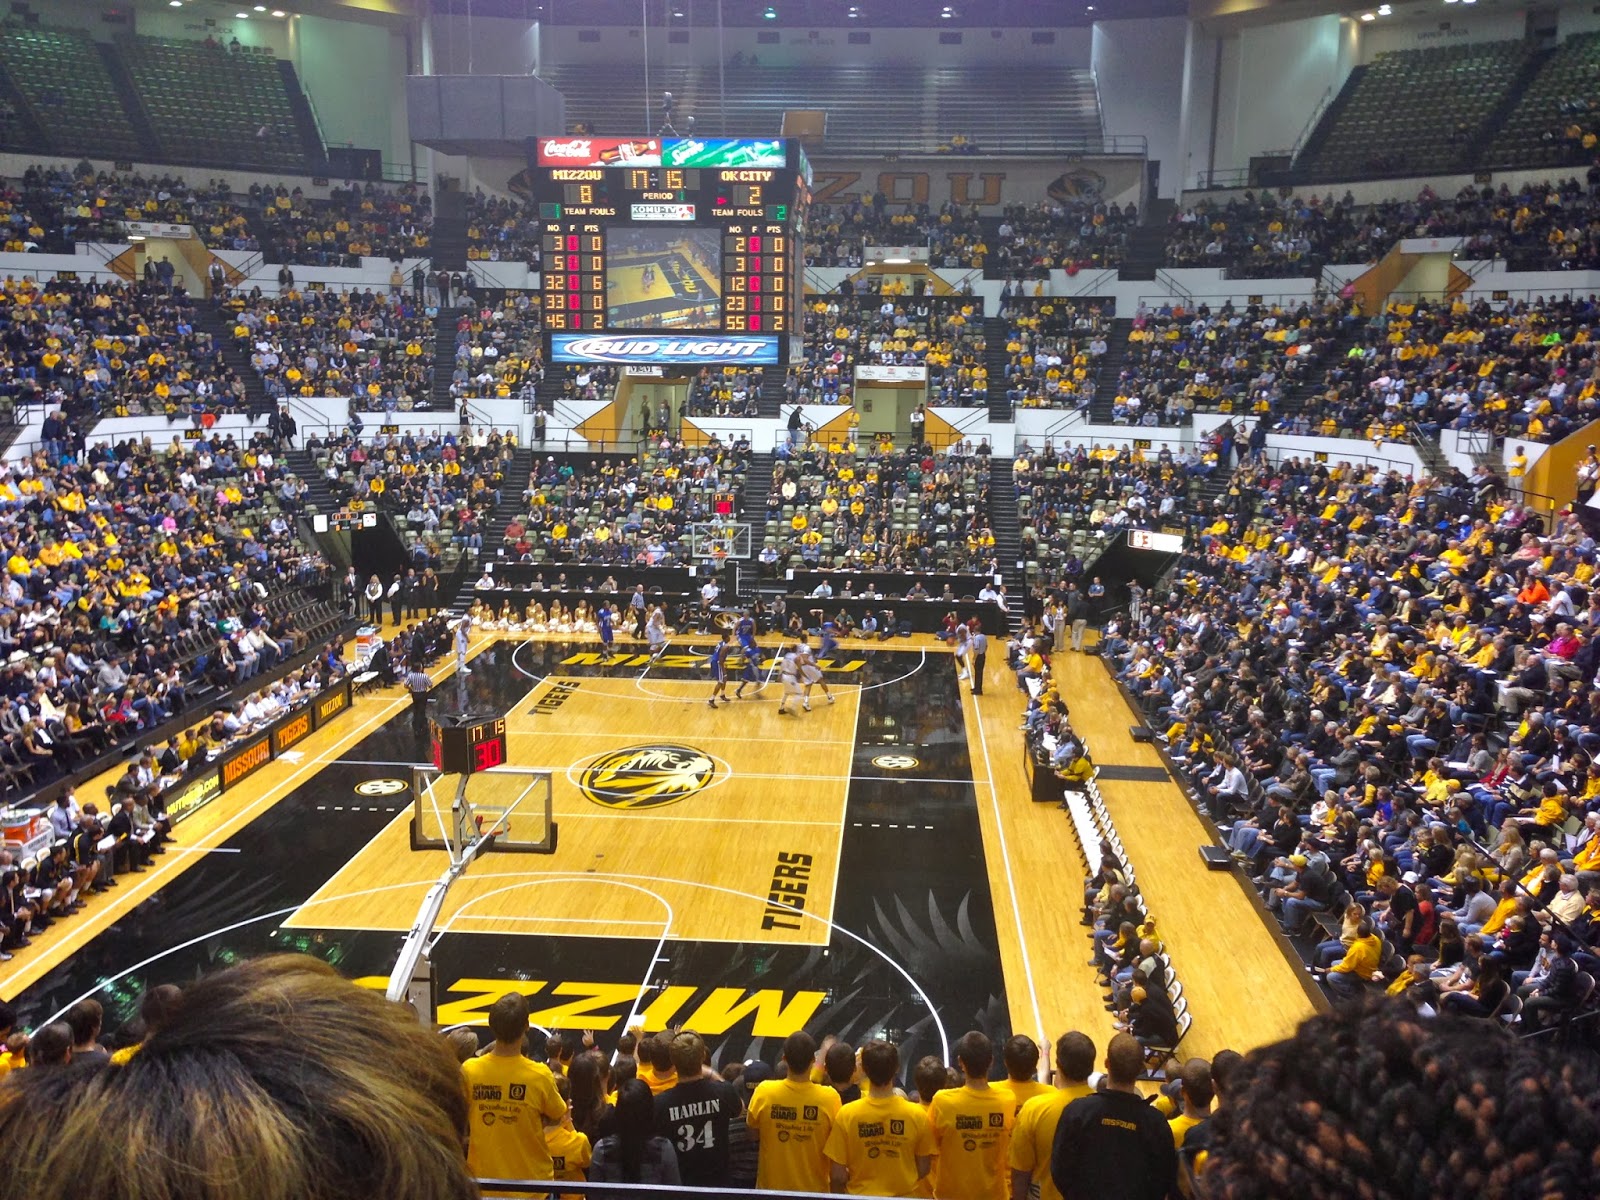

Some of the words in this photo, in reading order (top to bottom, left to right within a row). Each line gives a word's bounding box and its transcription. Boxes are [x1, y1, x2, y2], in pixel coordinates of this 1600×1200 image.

[552, 169, 602, 180] MIZZOU
[721, 171, 739, 181] OK
[740, 171, 772, 181] CITY
[580, 185, 592, 203] 8
[749, 186, 760, 205] 2
[564, 207, 586, 215] TEAM
[589, 208, 616, 216] FOULS
[632, 205, 677, 213] KOMU-TV
[777, 205, 786, 220] 2
[554, 236, 563, 250] 3
[592, 236, 601, 251] 0
[736, 237, 745, 252] 2
[774, 237, 783, 252] 0
[554, 256, 563, 270] 5
[592, 256, 602, 270] 0
[736, 257, 745, 272] 3
[774, 257, 783, 272] 0
[546, 275, 564, 290] 32
[593, 276, 602, 290] 6
[732, 277, 745, 291] 12
[774, 277, 783, 291] 0
[546, 295, 564, 309] 33
[593, 295, 602, 309] 0
[726, 297, 745, 311] 23
[774, 297, 783, 311] 0
[546, 314, 565, 328] 45
[593, 314, 602, 328] 2
[726, 316, 745, 330] 55
[774, 316, 783, 330] 2
[585, 341, 659, 355] BUD
[662, 341, 767, 355] LIGHT
[527, 681, 581, 715] TIGERS
[278, 713, 308, 748] TIGERS
[472, 725, 483, 742] 17
[494, 719, 505, 735] 15
[224, 736, 270, 785] MISSOURI
[475, 738, 501, 772] 30
[761, 852, 812, 931] TIGERS
[353, 976, 826, 1038] MIZZ
[473, 1090, 502, 1100] GUARD
[669, 1099, 720, 1121] HARLIN
[1101, 1118, 1137, 1131] MISSOURI
[677, 1120, 716, 1152] 34
